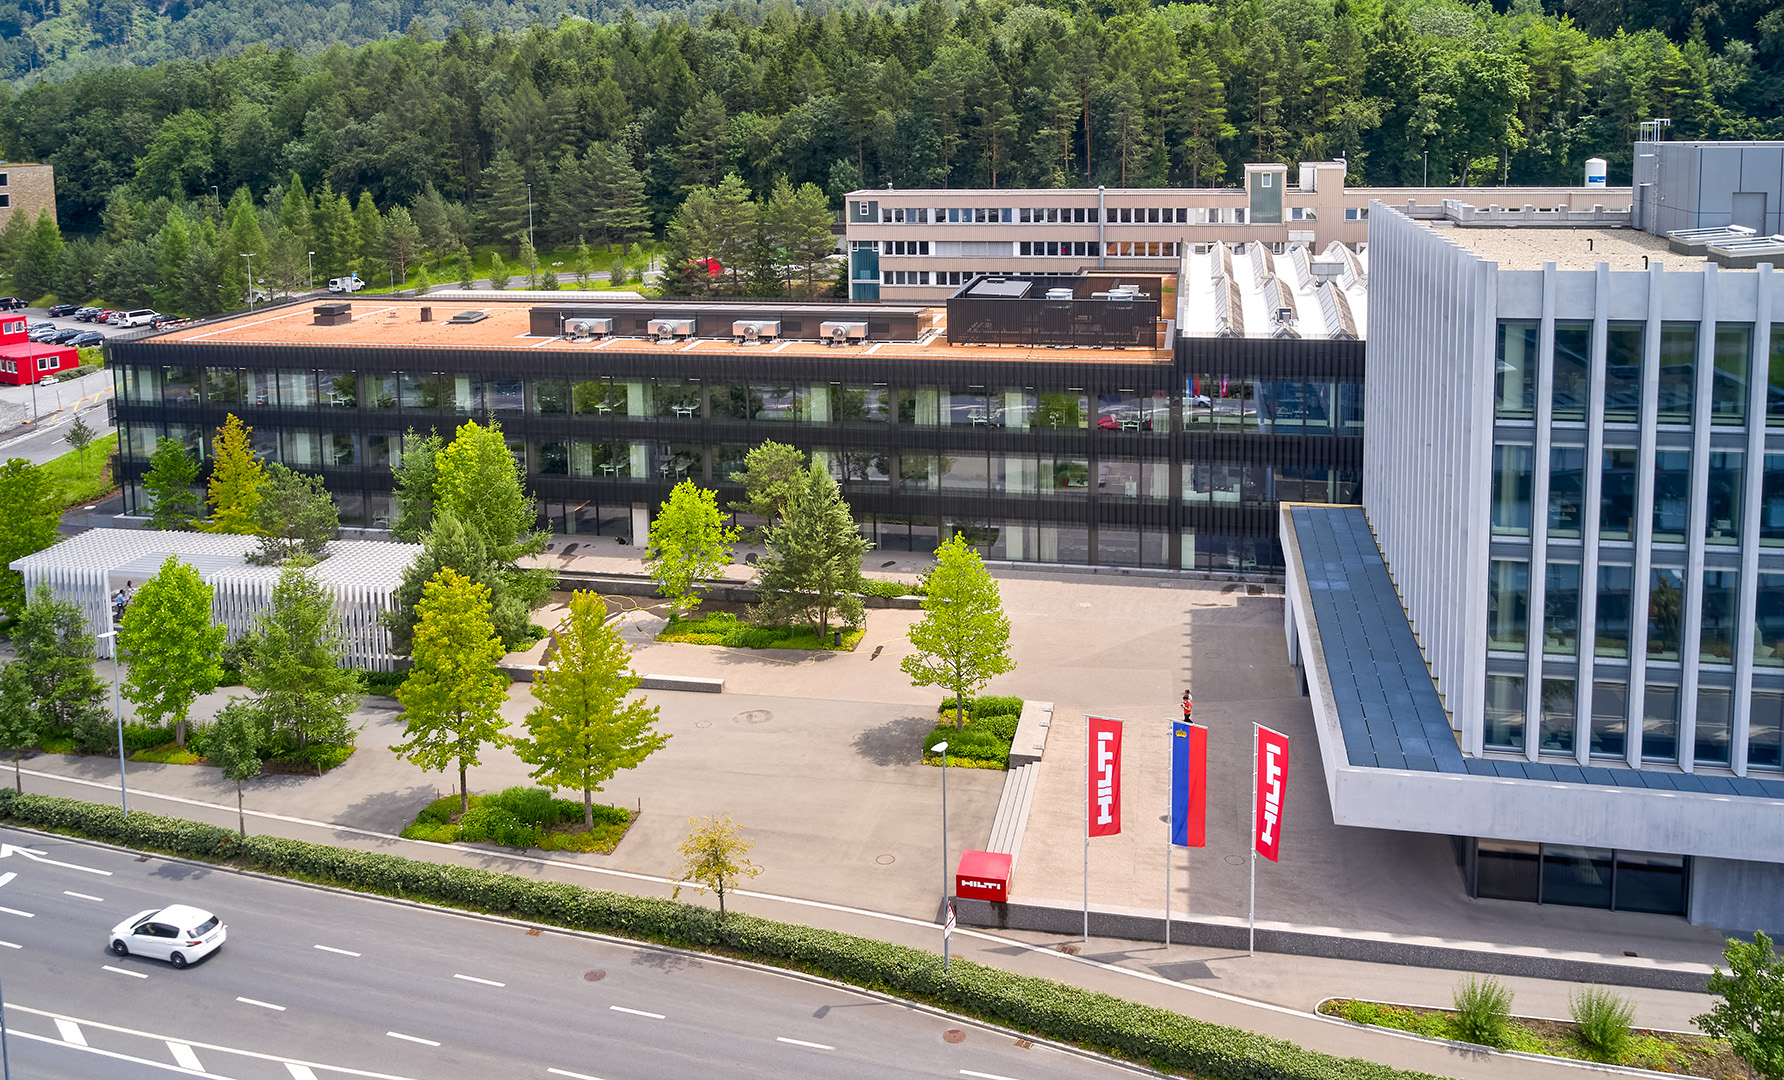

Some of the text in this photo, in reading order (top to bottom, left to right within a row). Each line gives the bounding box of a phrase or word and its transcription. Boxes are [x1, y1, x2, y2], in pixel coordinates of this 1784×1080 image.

[1097, 731, 1114, 825] HILTI
[1261, 742, 1282, 846] HILTI
[961, 880, 1001, 890] HILTI
